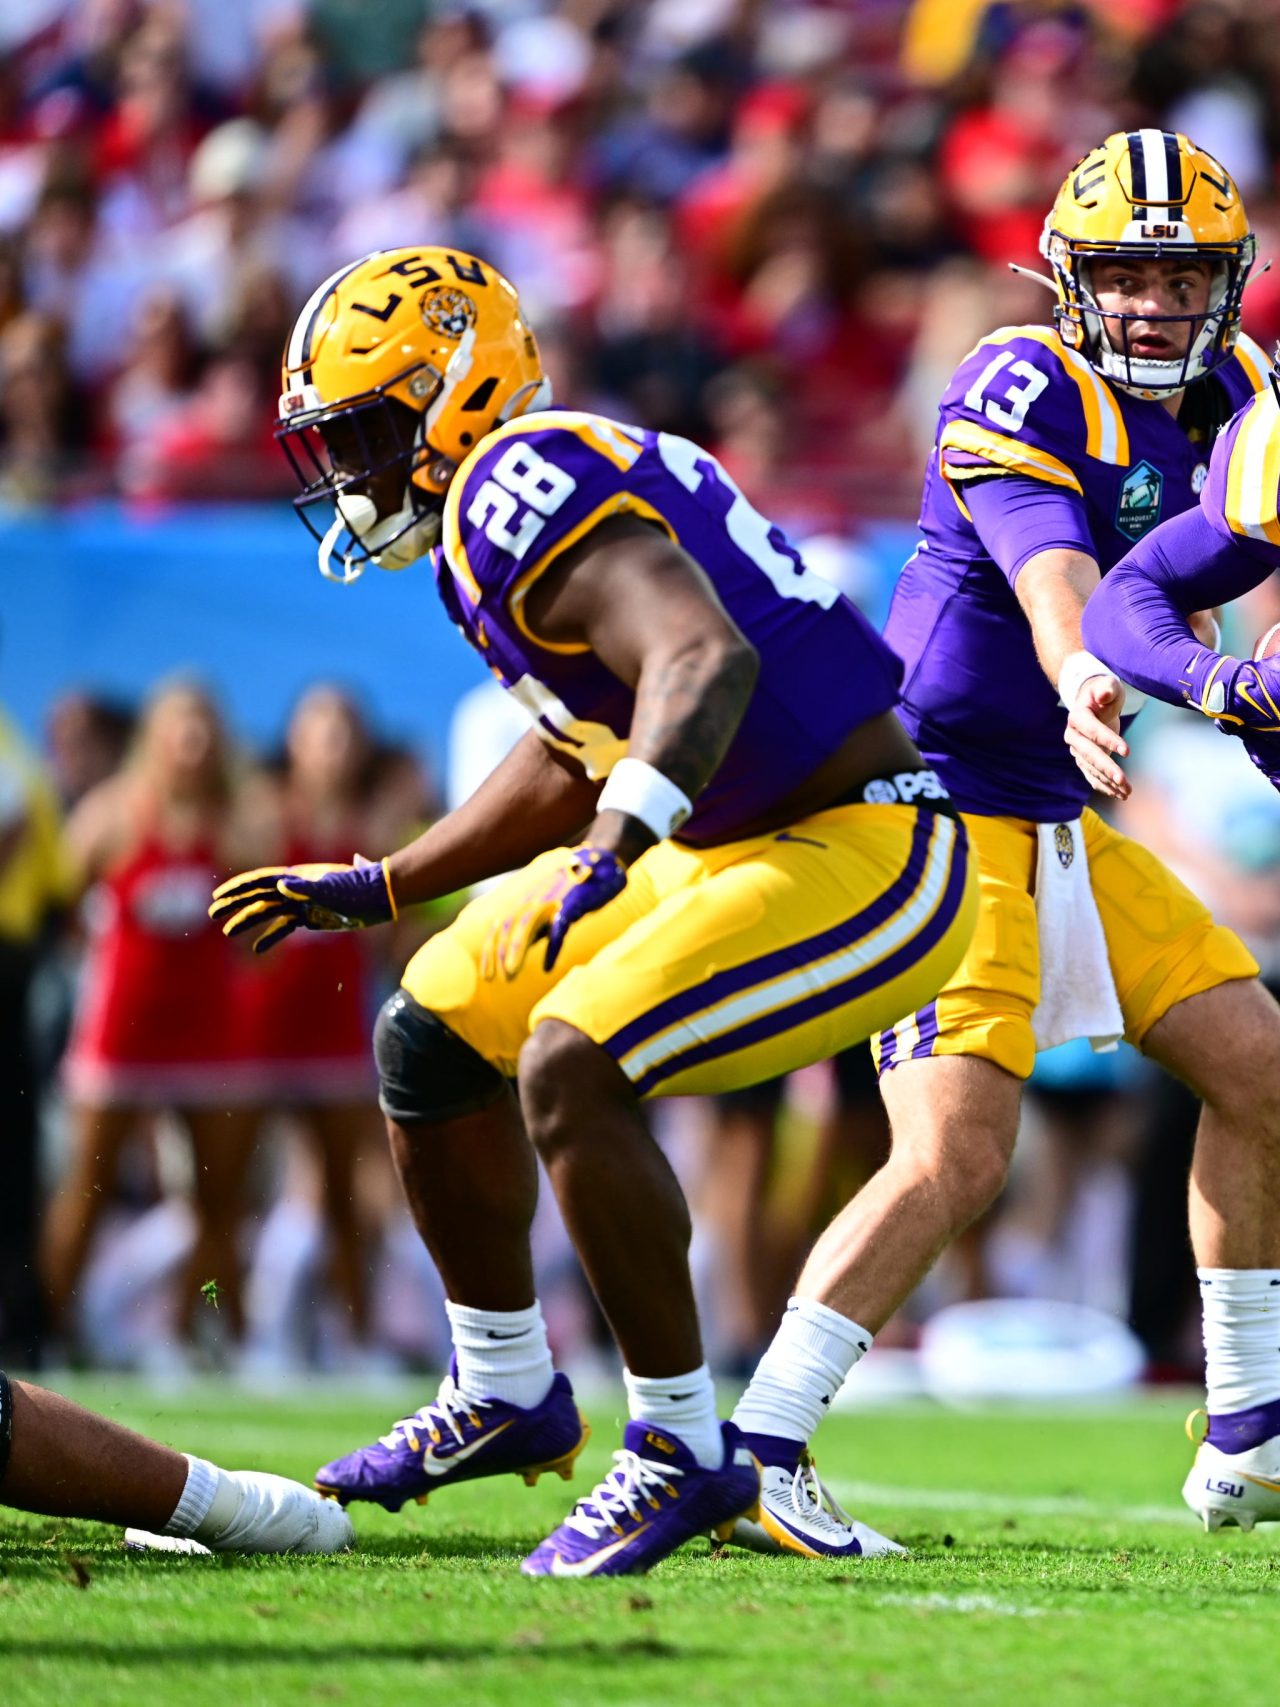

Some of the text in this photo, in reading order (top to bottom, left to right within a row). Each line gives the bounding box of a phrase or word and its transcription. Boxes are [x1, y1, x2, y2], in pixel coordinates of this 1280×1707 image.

[1141, 225, 1178, 238] LSU
[350, 255, 489, 323] LSU
[964, 351, 1049, 433] 13
[466, 441, 577, 560] 28
[893, 770, 950, 804] PS
[1205, 1478, 1245, 1498] LSU
